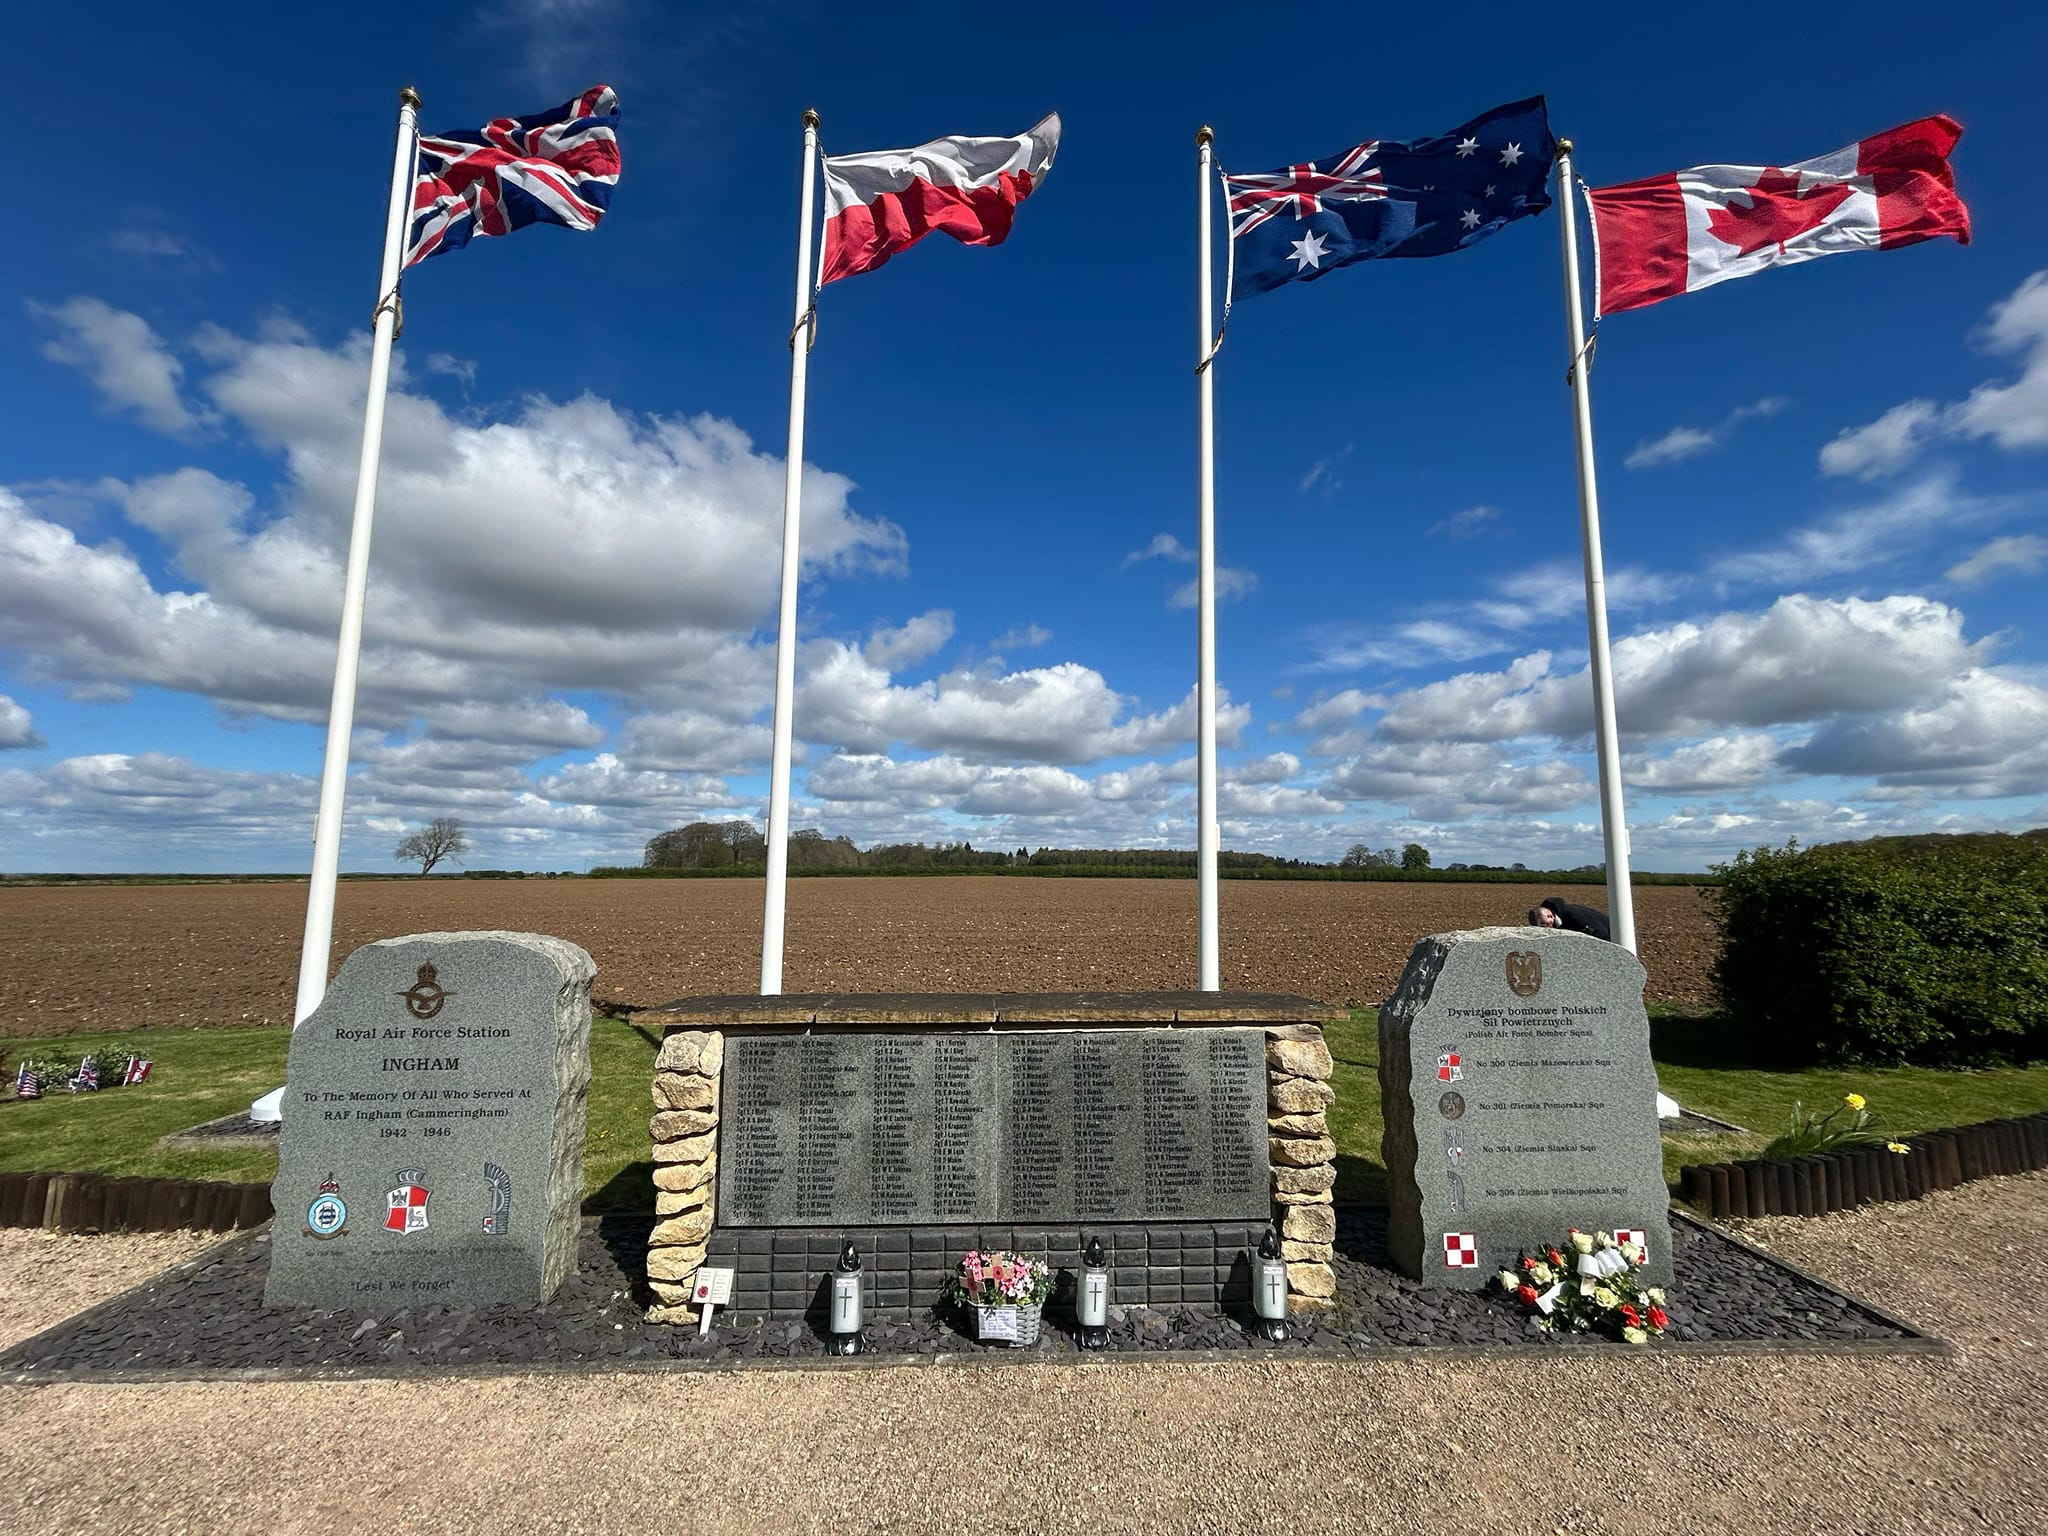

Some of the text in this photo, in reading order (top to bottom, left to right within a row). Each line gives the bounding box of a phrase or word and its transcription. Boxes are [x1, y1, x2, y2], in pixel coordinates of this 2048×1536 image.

[1508, 1007, 1557, 1016] bombowe
[1562, 1006, 1607, 1015] Polskich
[1502, 1017, 1573, 1028] Powietrznych
[335, 1026, 510, 1041] Royal Air Force Station
[1495, 1030, 1509, 1038] Air
[1511, 1030, 1534, 1038] Force
[382, 1057, 460, 1071] INGHAM
[1476, 1060, 1487, 1068] No
[1490, 1060, 1505, 1068] 300
[1594, 1059, 1611, 1068] Sqn
[303, 1089, 531, 1103] To The Memory Of All Who Served At
[1493, 1102, 1507, 1110] 301
[1588, 1101, 1605, 1110] Sqn
[324, 1108, 509, 1121] RAF Ingham (Cammeringham)
[379, 1127, 452, 1138] 1942 1946
[1482, 1145, 1494, 1153] No
[1496, 1145, 1511, 1153] 304
[1580, 1144, 1597, 1152] Sqn
[1485, 1189, 1497, 1197] No
[1499, 1188, 1515, 1197] 305
[1611, 1187, 1628, 1196] Sqn
[389, 1280, 406, 1291] We
